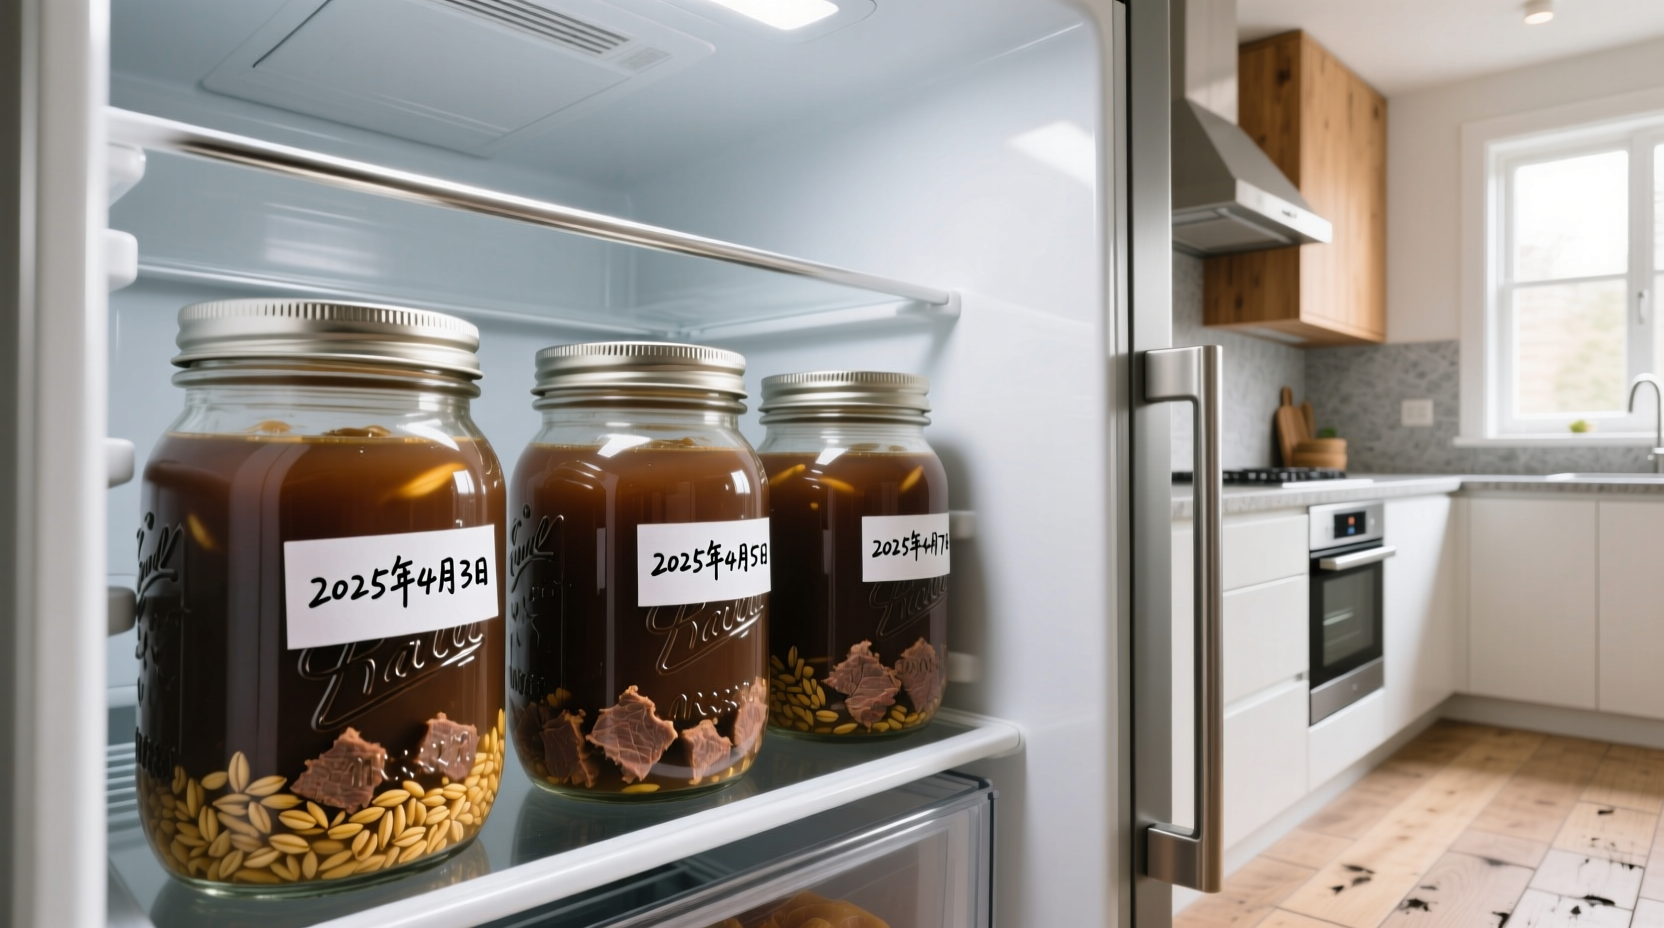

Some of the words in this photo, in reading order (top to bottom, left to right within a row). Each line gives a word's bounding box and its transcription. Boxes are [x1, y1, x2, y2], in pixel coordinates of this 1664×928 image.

[308, 554, 489, 609] 2025年4月3日
[650, 539, 768, 581] 2025年4月5日
